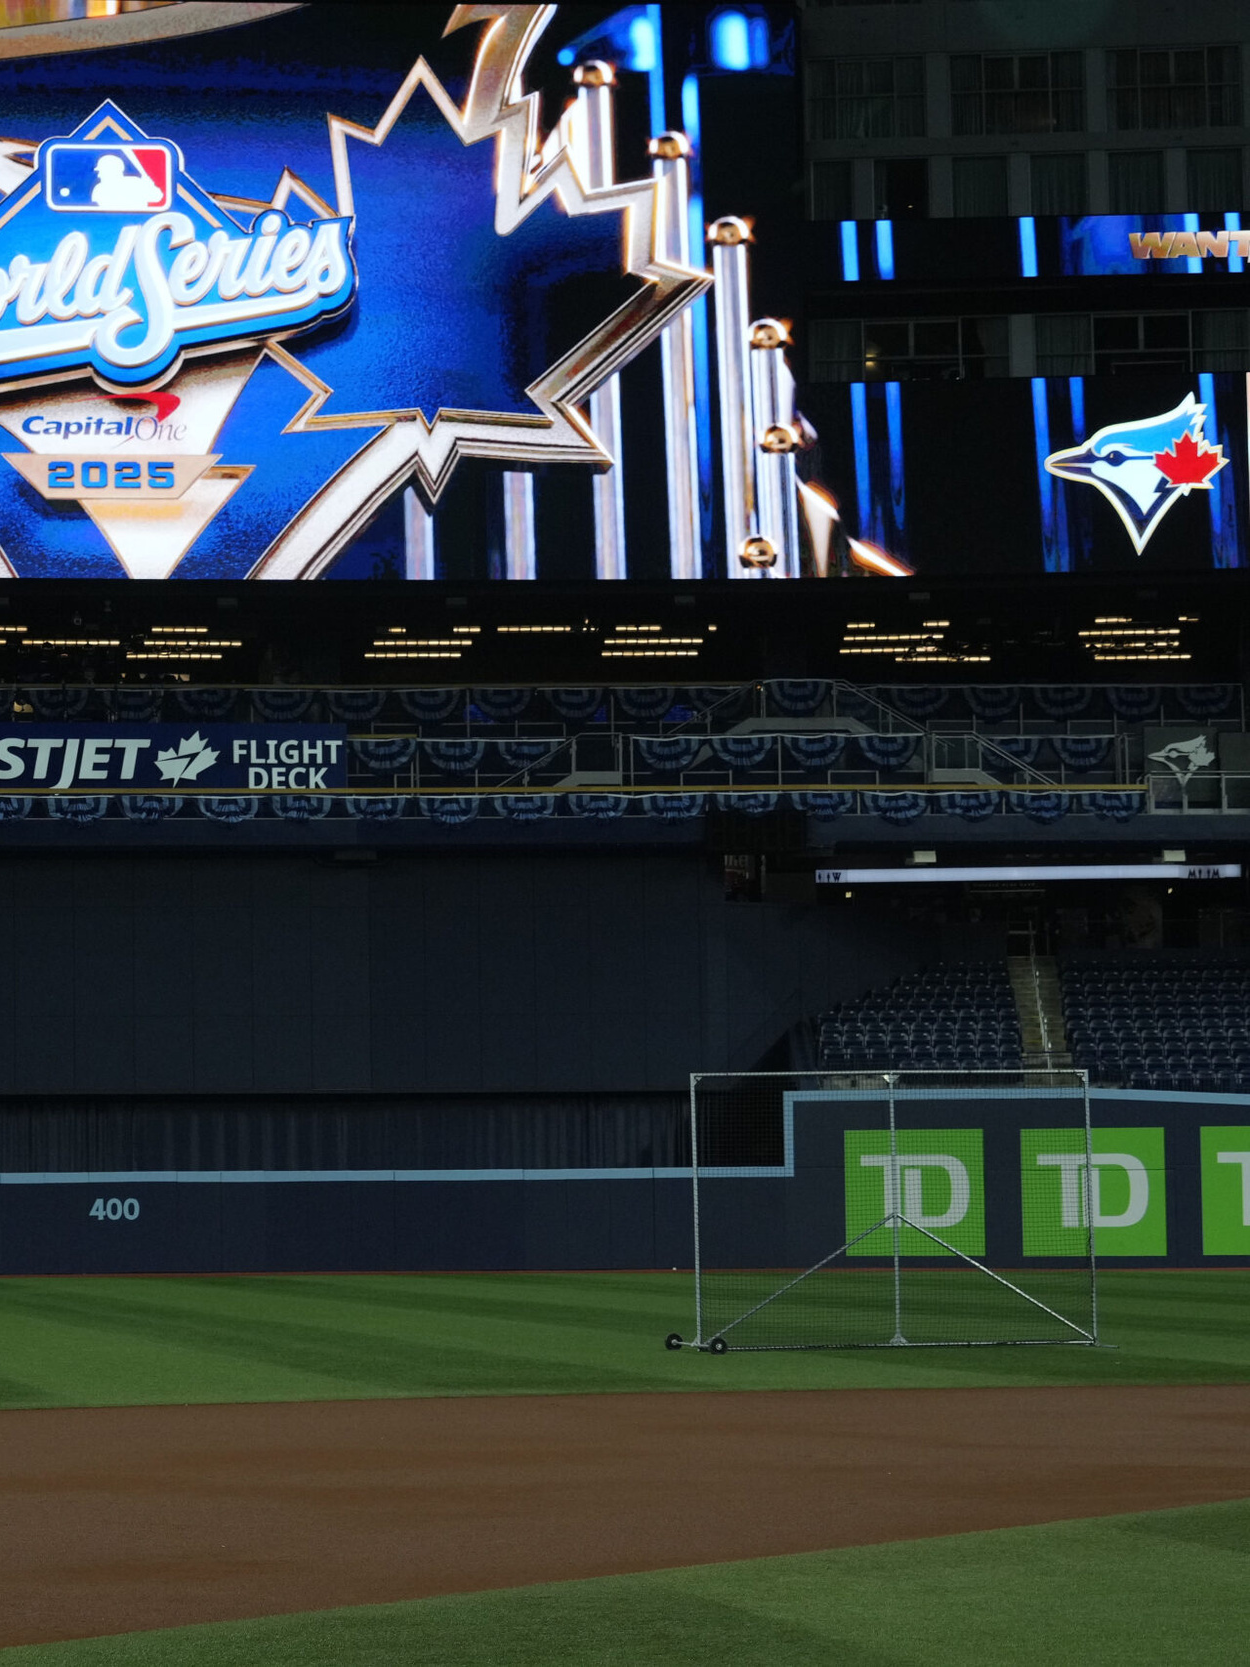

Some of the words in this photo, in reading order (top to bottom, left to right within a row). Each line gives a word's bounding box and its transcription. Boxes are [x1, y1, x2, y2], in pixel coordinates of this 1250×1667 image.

[95, 211, 348, 367] Series
[47, 461, 175, 490] 2025
[232, 739, 343, 766] FLIGHT
[248, 767, 327, 789] DECK
[860, 1154, 970, 1228] TD
[1036, 1153, 1149, 1228] TD
[89, 1198, 140, 1221] 400
